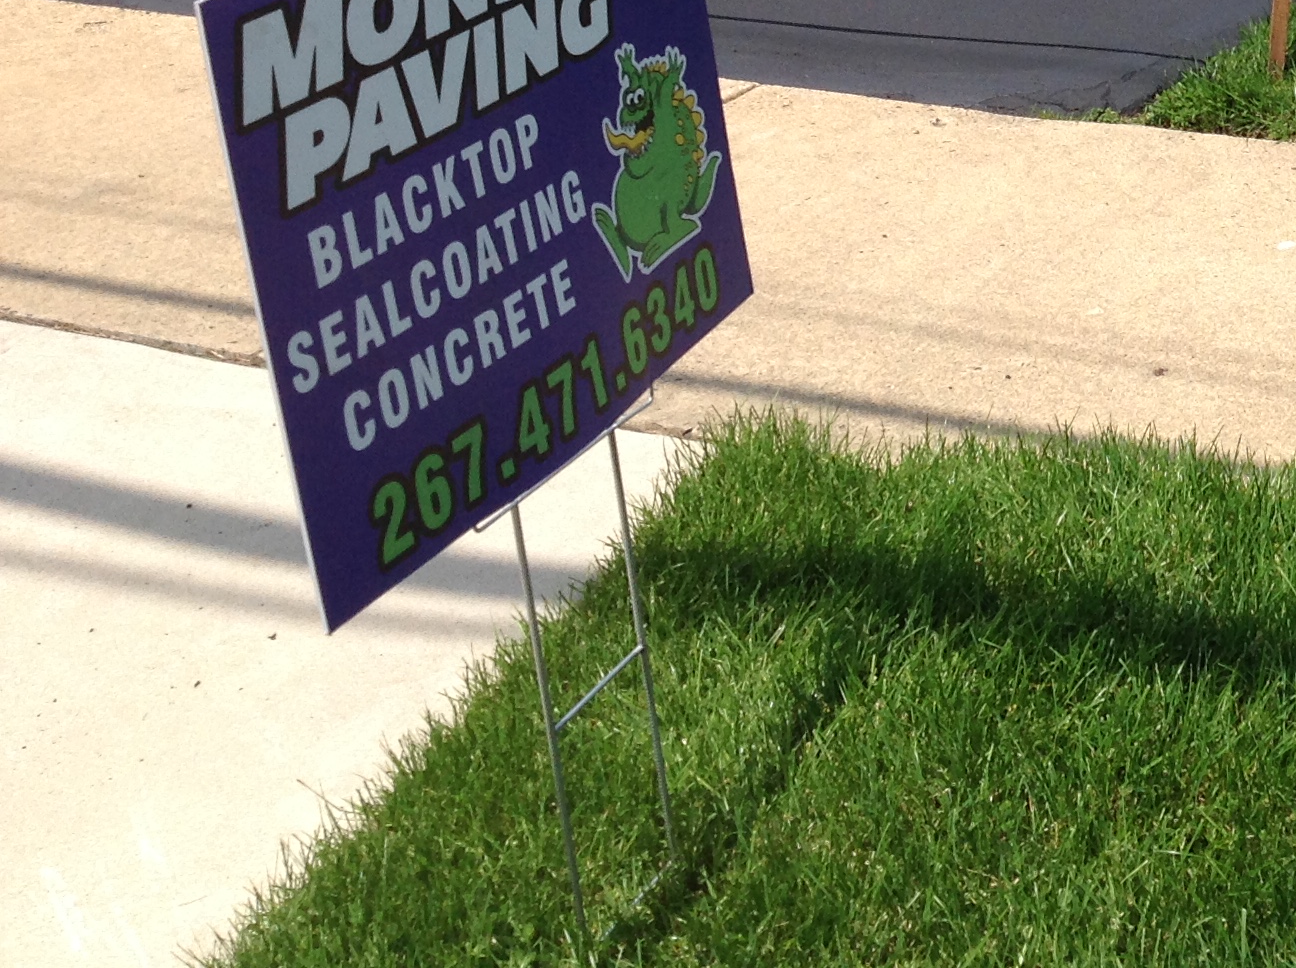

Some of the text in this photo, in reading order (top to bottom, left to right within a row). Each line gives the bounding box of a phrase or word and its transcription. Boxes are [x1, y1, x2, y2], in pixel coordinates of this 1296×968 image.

[287, 169, 588, 394] SEALCOATING
[307, 113, 541, 289] BLACKTOP
[343, 259, 577, 452] CONCRETE
[372, 247, 720, 566] 267.471.6340
